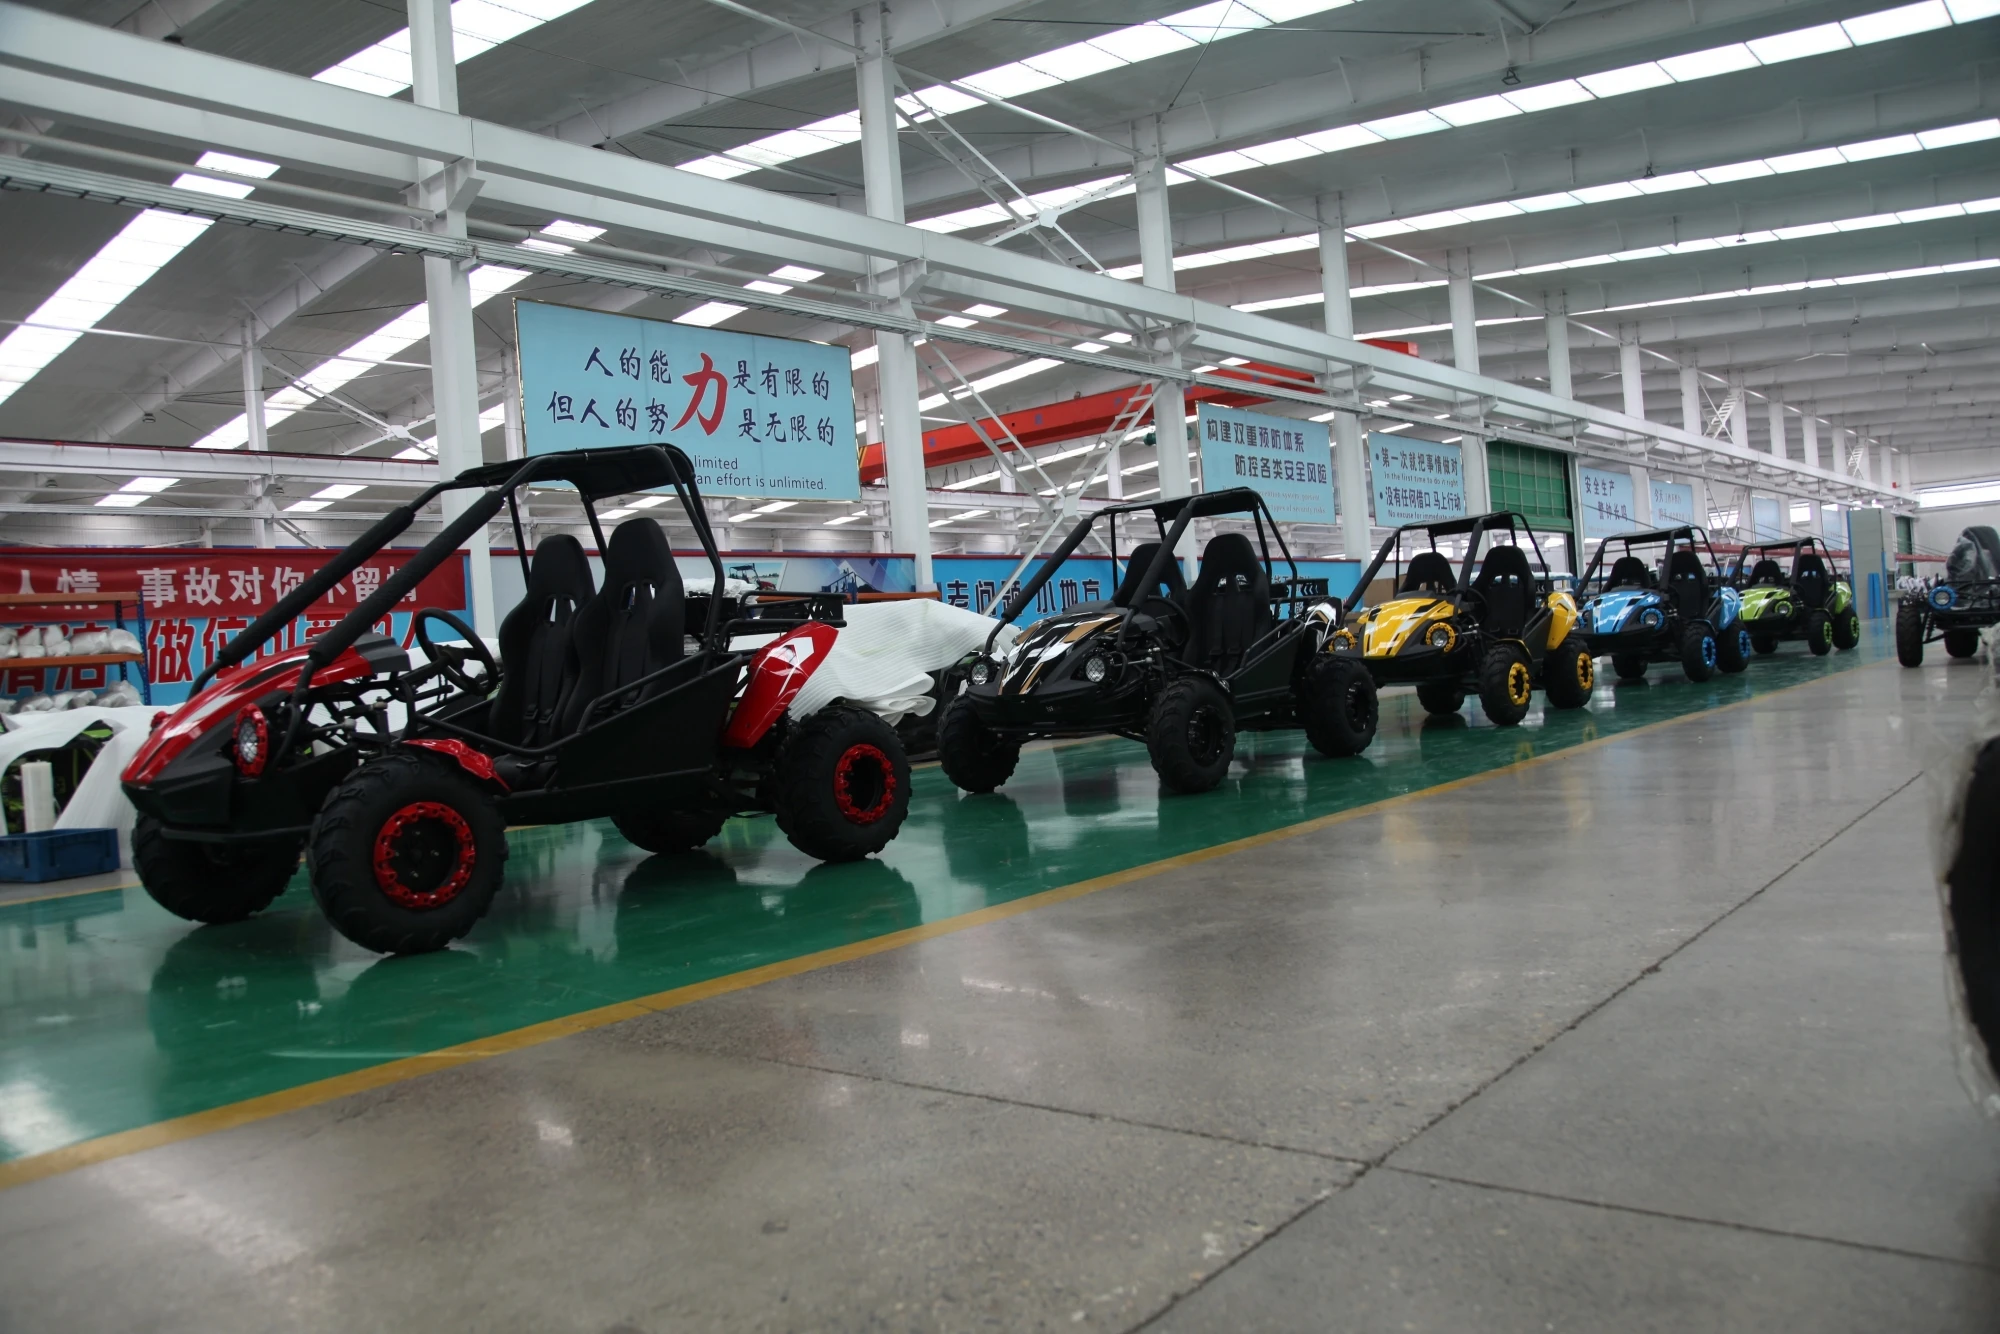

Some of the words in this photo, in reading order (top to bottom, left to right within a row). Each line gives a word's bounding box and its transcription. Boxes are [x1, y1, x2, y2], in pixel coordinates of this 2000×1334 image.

[585, 346, 672, 385] 人的能
[670, 352, 729, 436] 力
[732, 360, 831, 401] 是有限的
[547, 391, 669, 436] 但人的努
[738, 408, 836, 447] 是无限的
[1206, 418, 1305, 453] 构建双重预防体系
[693, 455, 739, 471] limited
[1235, 454, 1327, 484] 防控各类安全风险
[1381, 446, 1458, 476] 第一次就把事情做对
[694, 475, 712, 485] an
[717, 474, 752, 487] effort
[755, 475, 765, 488] is
[769, 476, 828, 491] unlimited.
[1584, 475, 1615, 497] 安全生产
[1433, 490, 1462, 512] 马上行动
